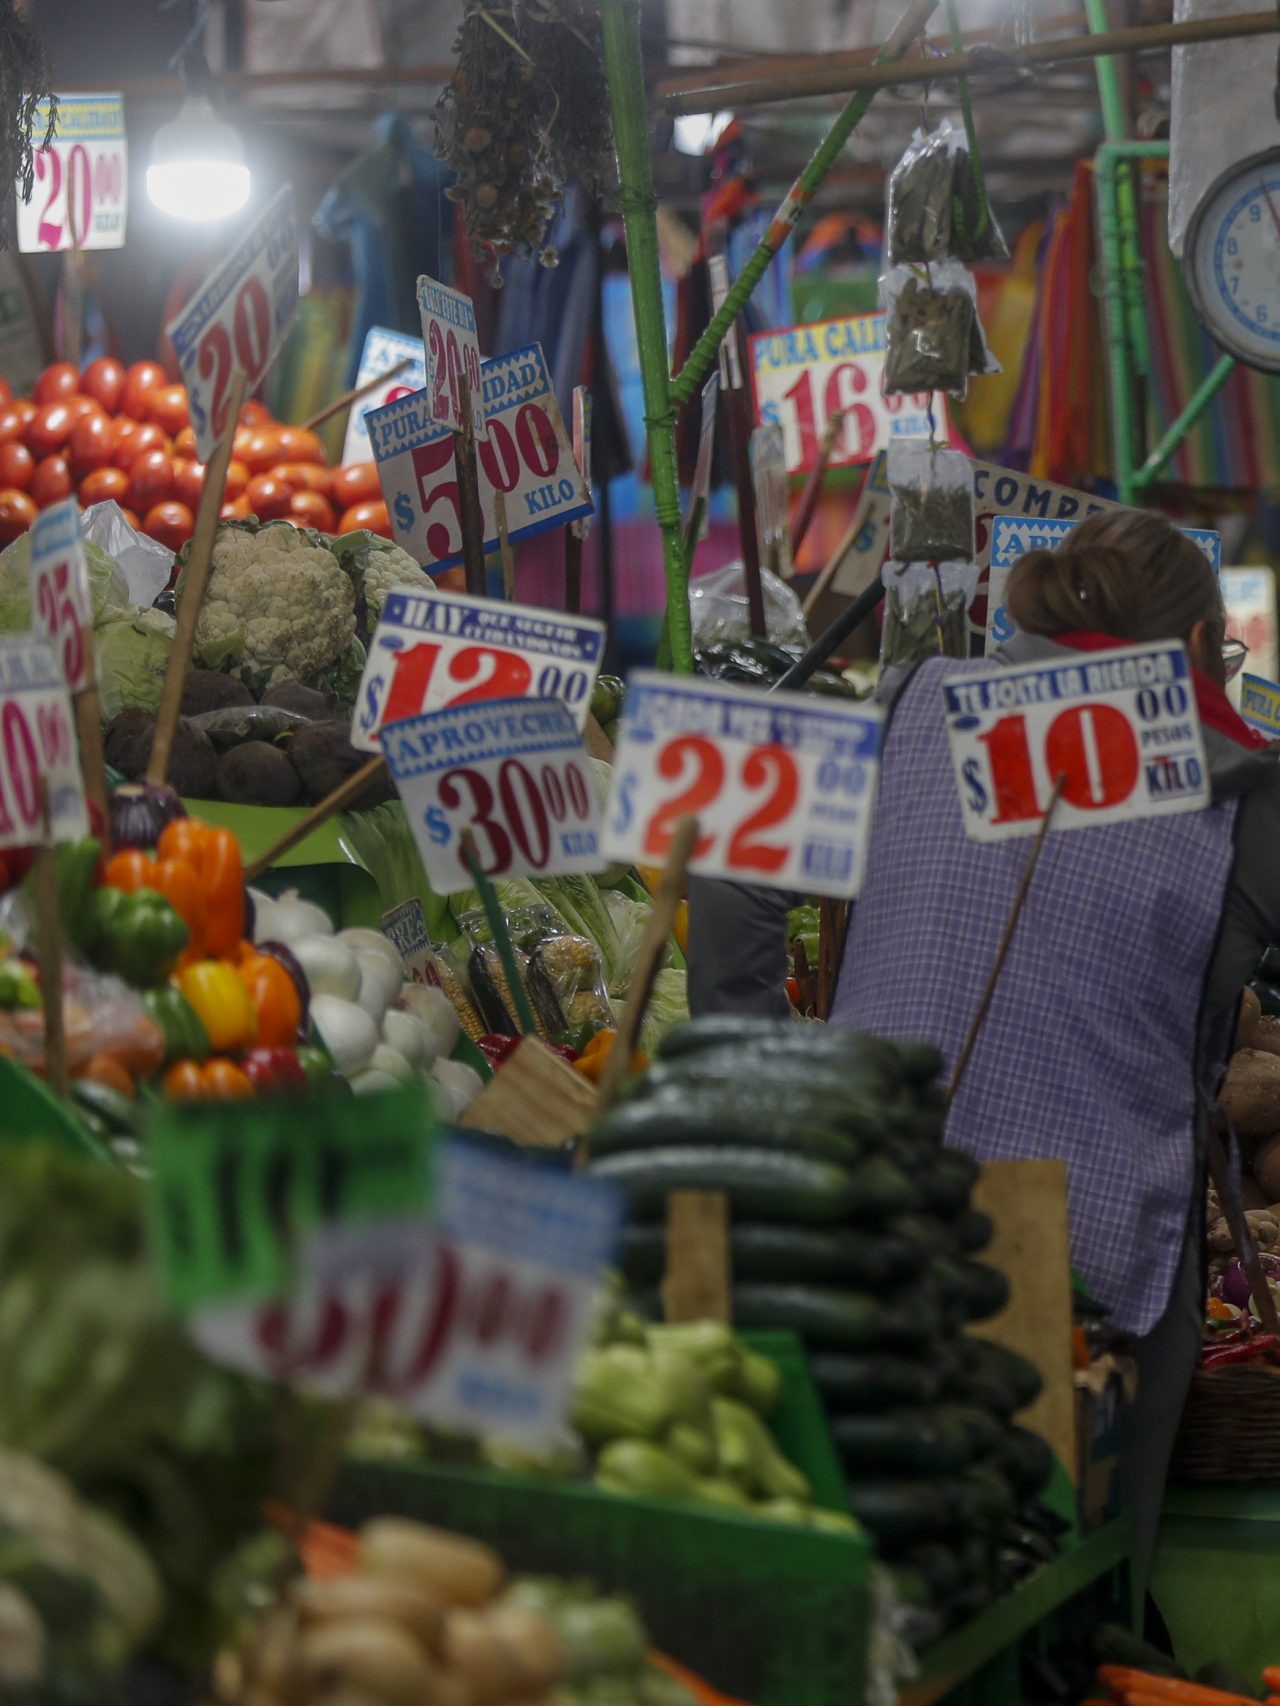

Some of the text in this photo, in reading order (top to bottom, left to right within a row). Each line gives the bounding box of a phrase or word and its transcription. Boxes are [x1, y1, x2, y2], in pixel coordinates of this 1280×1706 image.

[35, 144, 92, 252] 20
[1250, 203, 1262, 222] 9
[1226, 237, 1238, 256] 8
[1230, 277, 1240, 295] 7
[1255, 304, 1268, 324] 6
[379, 363, 537, 447] PURA IDAD
[477, 402, 560, 494] 00
[523, 478, 575, 516] KILO
[403, 598, 469, 638] HAY
[1135, 684, 1189, 723] 00
[396, 709, 577, 764] APROVECHE
